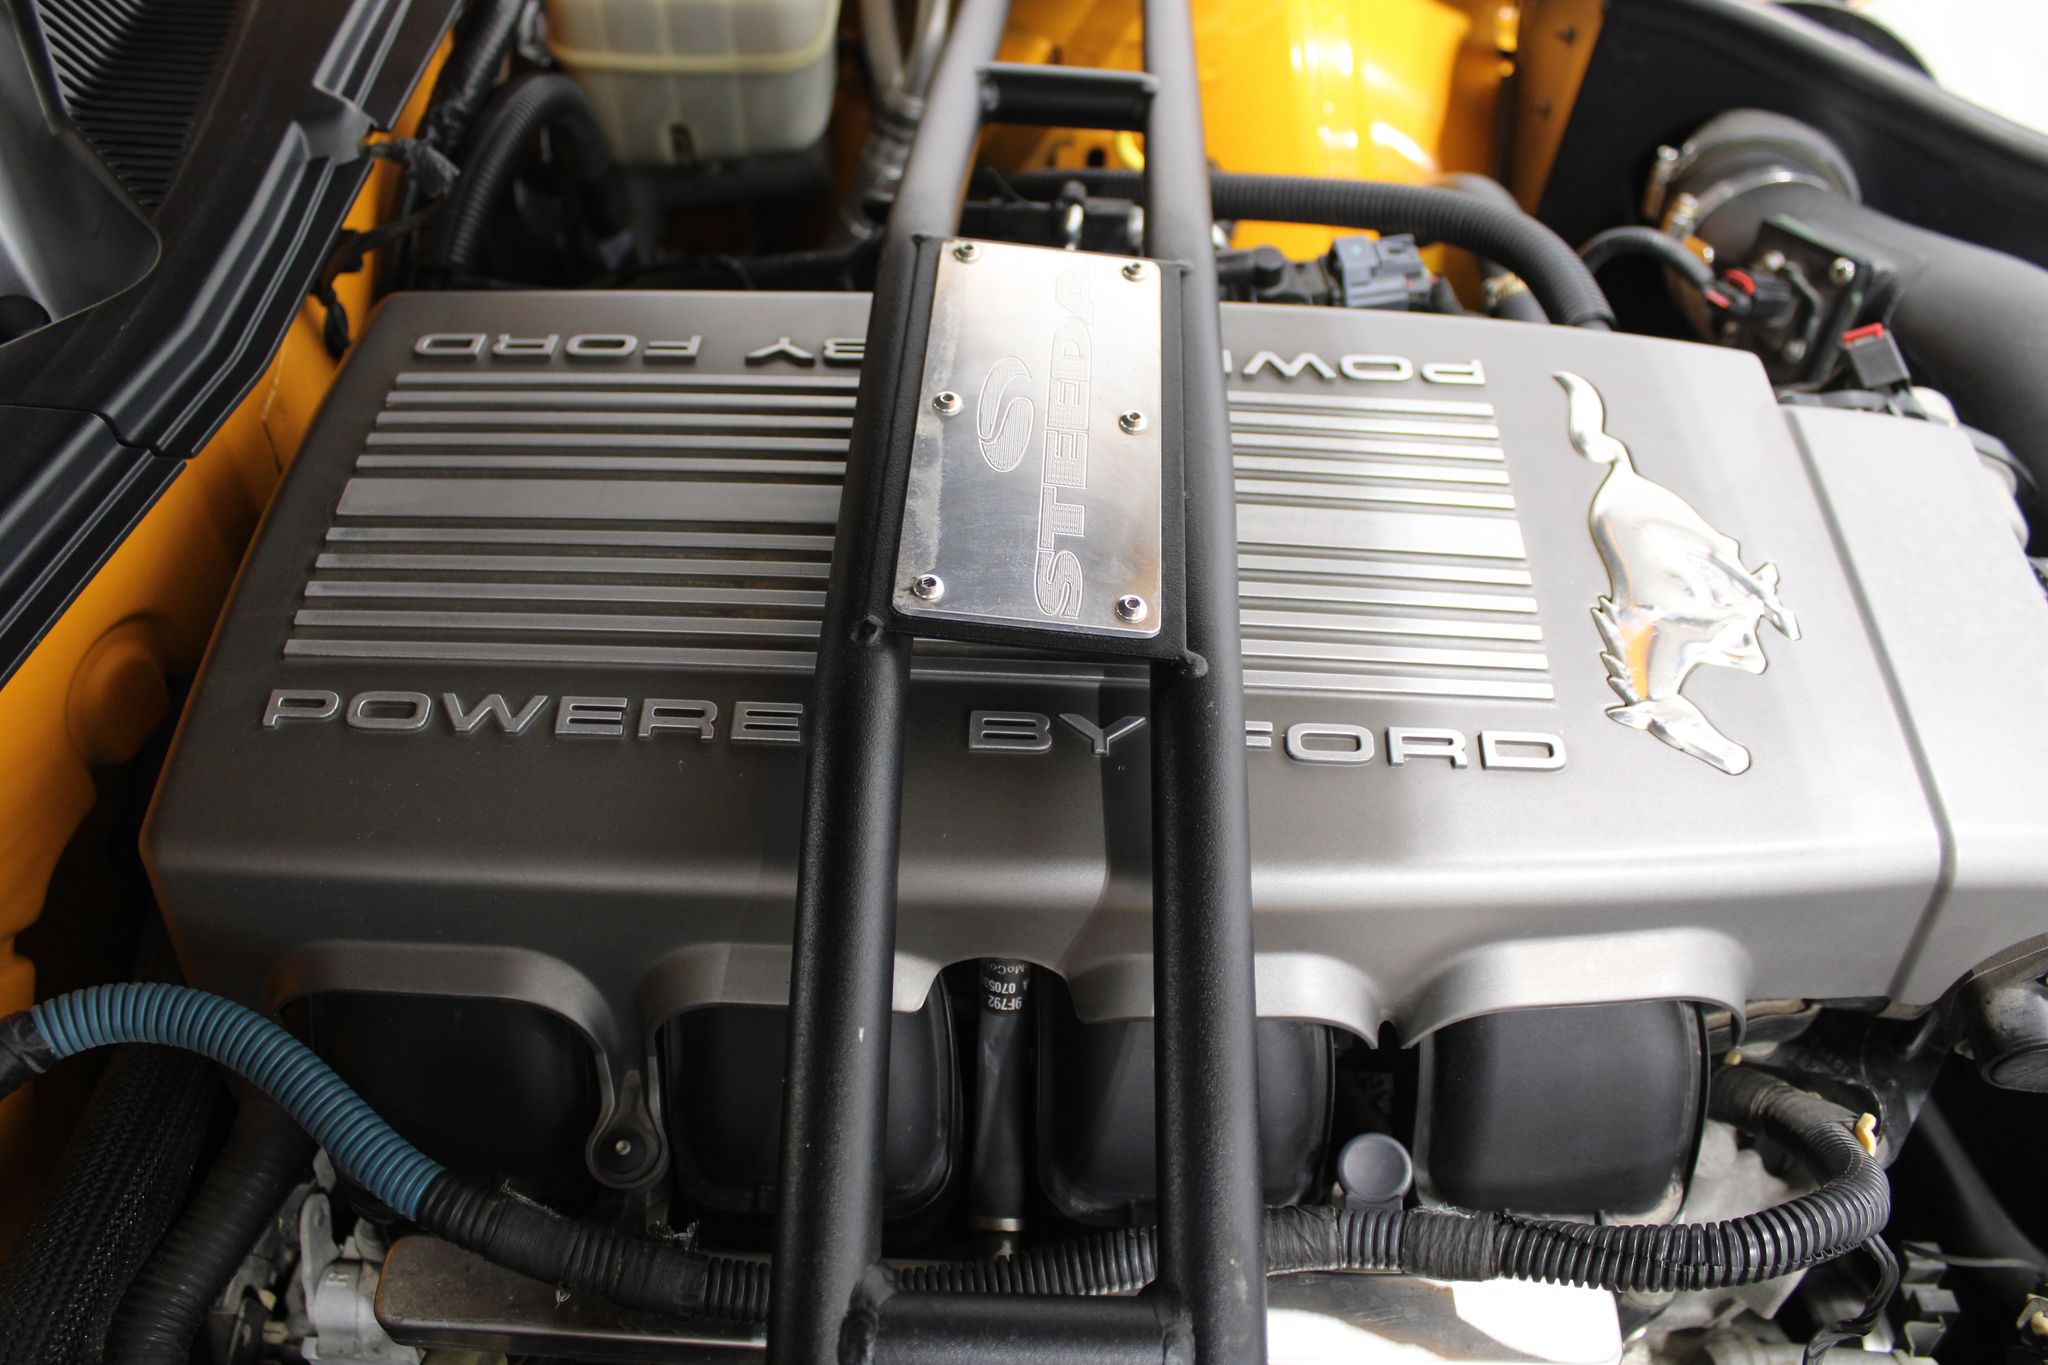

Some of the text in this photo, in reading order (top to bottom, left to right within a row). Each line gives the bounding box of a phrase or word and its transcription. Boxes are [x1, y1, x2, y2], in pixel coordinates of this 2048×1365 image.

[413, 333, 702, 363] FORD
[1033, 258, 1097, 619] STEEDA
[262, 688, 804, 745] POWERE
[968, 710, 1146, 756] BY
